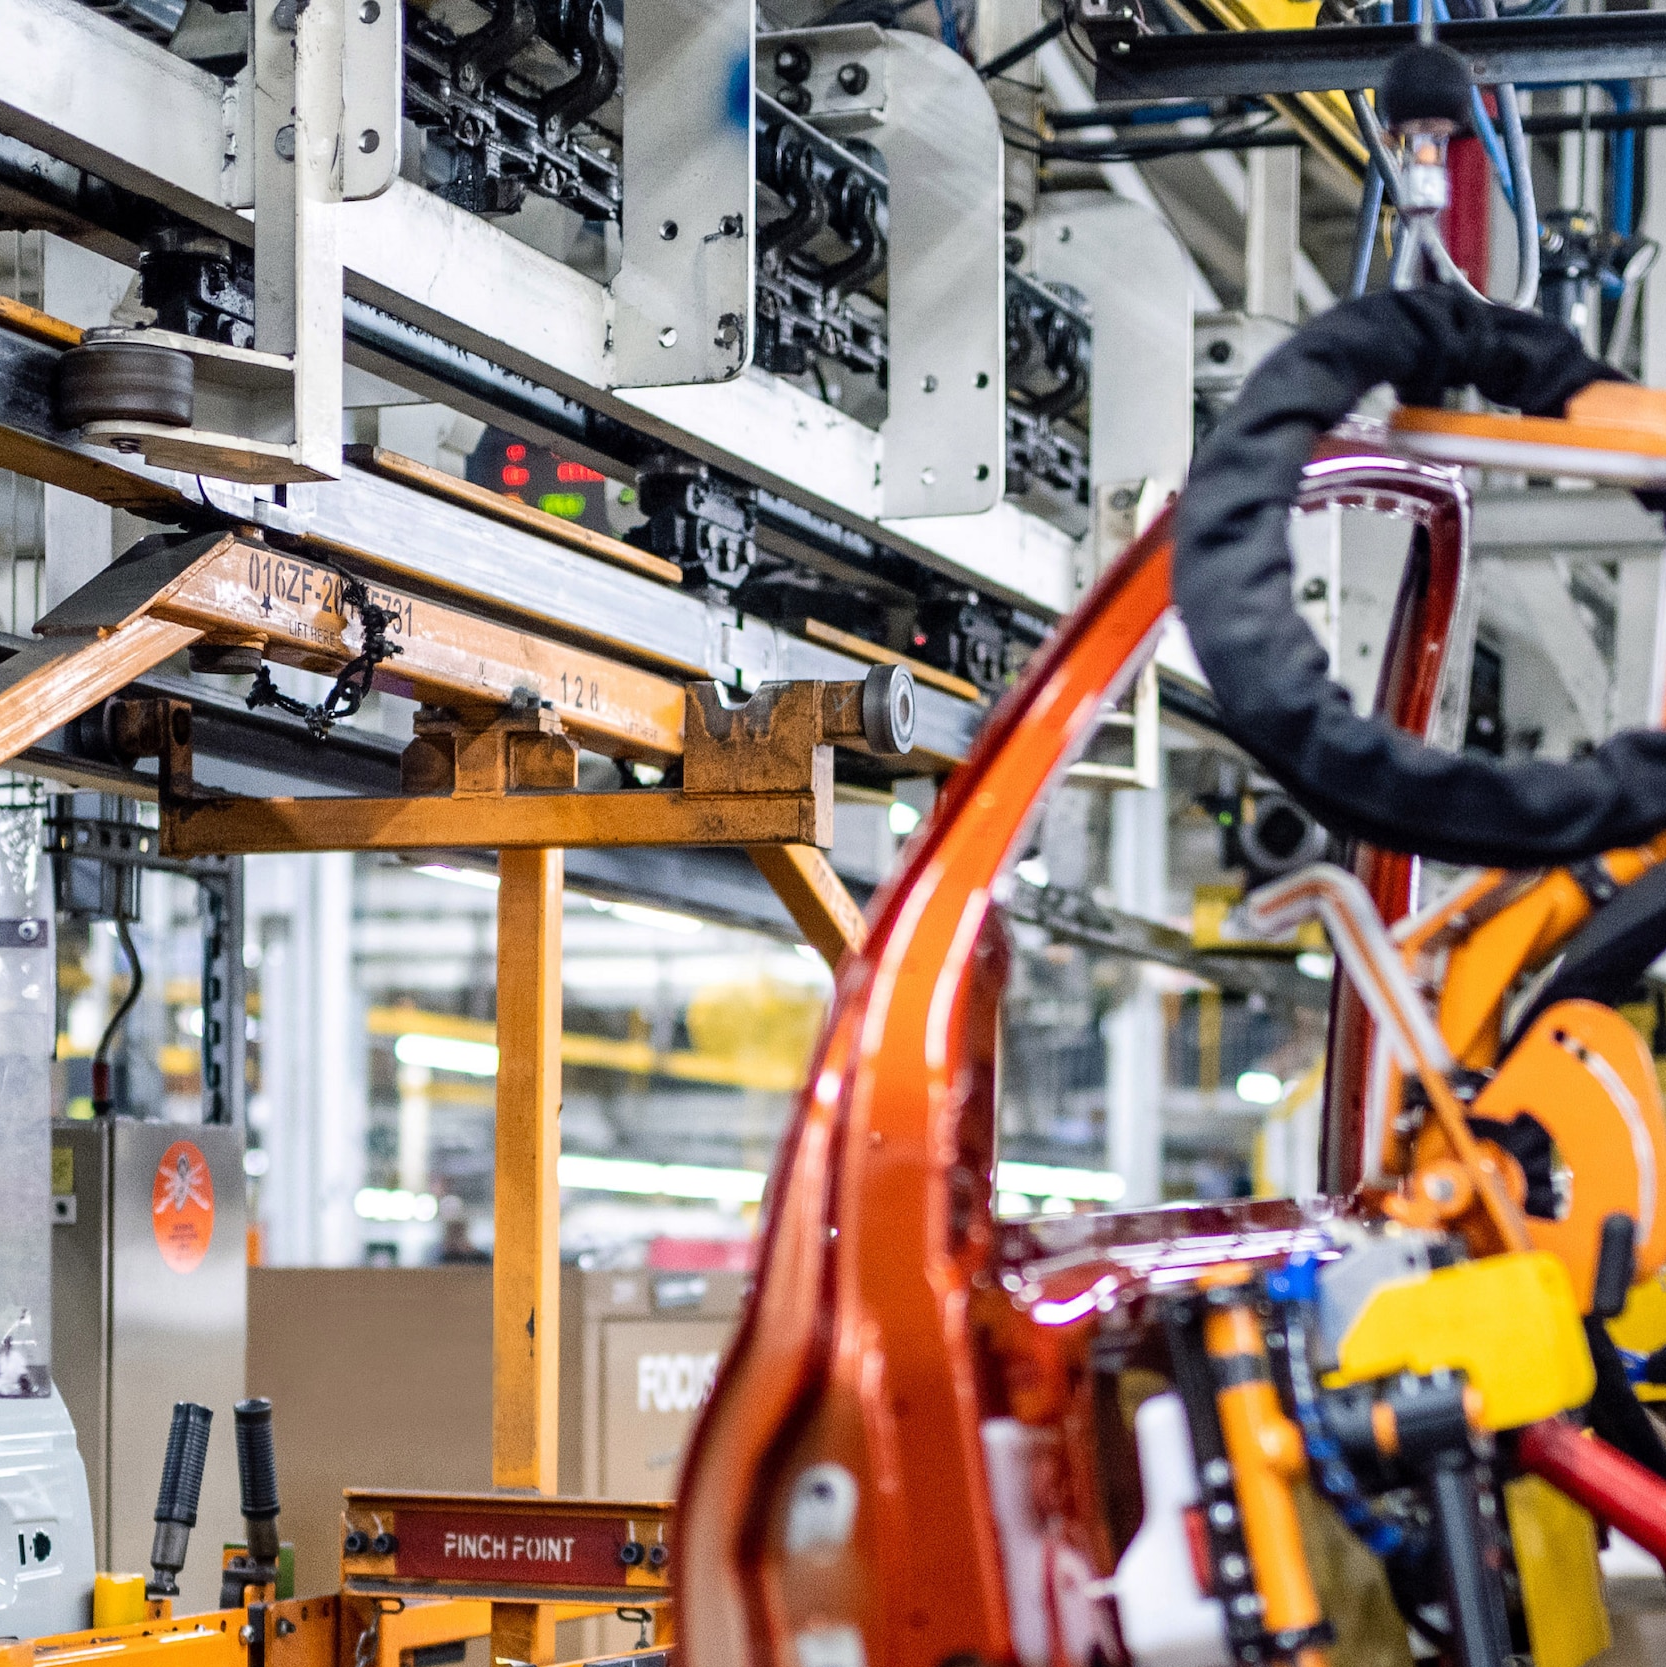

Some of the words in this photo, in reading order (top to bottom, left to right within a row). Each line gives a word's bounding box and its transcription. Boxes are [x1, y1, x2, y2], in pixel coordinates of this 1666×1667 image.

[288, 620, 308, 637] LIFT
[310, 627, 336, 646] HERE
[444, 1532, 506, 1560] PINCH
[513, 1535, 575, 1562] POINT
